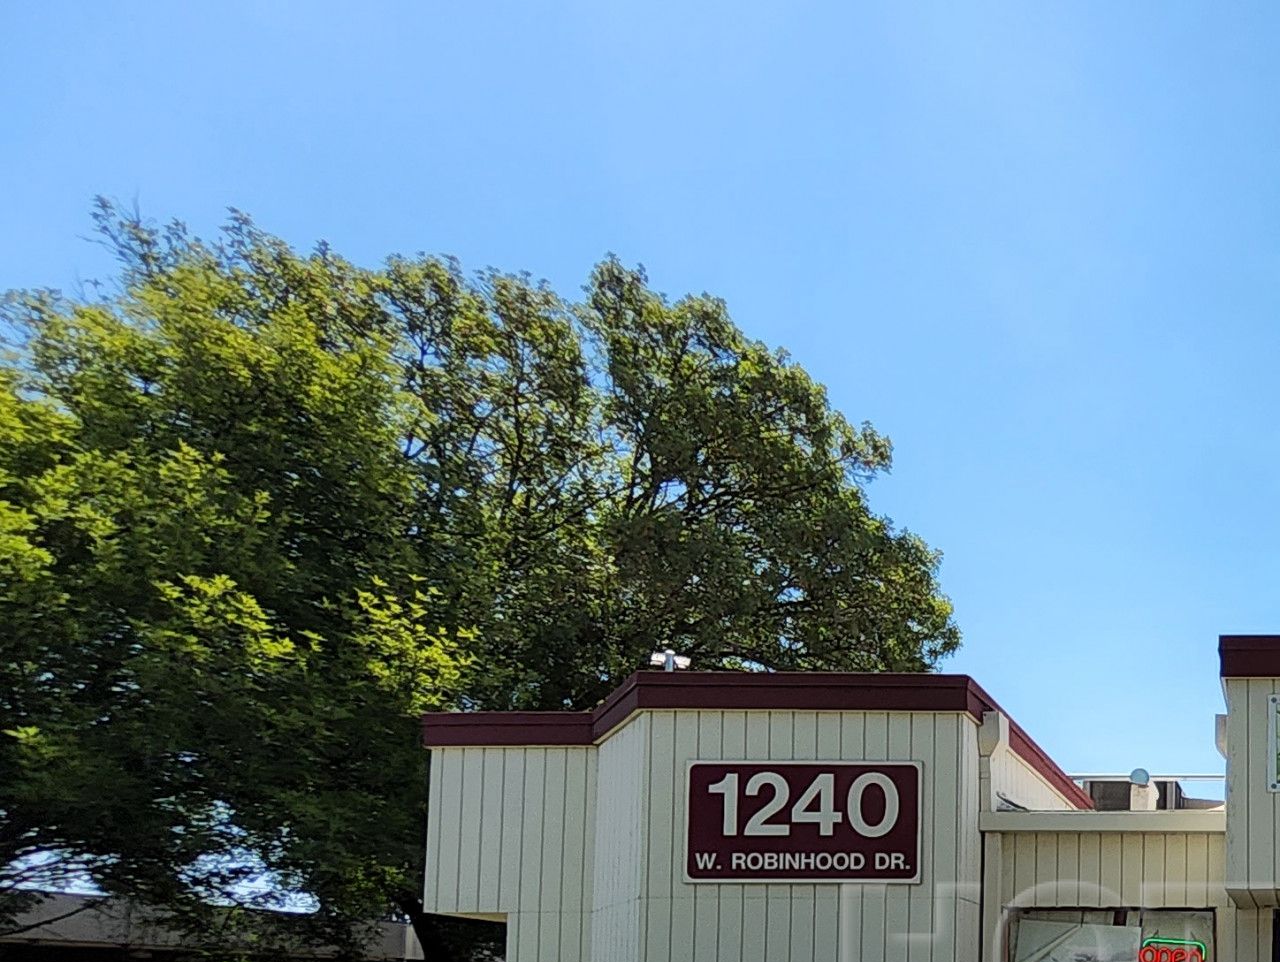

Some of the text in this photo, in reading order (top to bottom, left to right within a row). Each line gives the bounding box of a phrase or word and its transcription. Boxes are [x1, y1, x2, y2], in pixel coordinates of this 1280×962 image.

[707, 772, 900, 838] 1240
[694, 852, 911, 871] W. ROBINHOOD DR.
